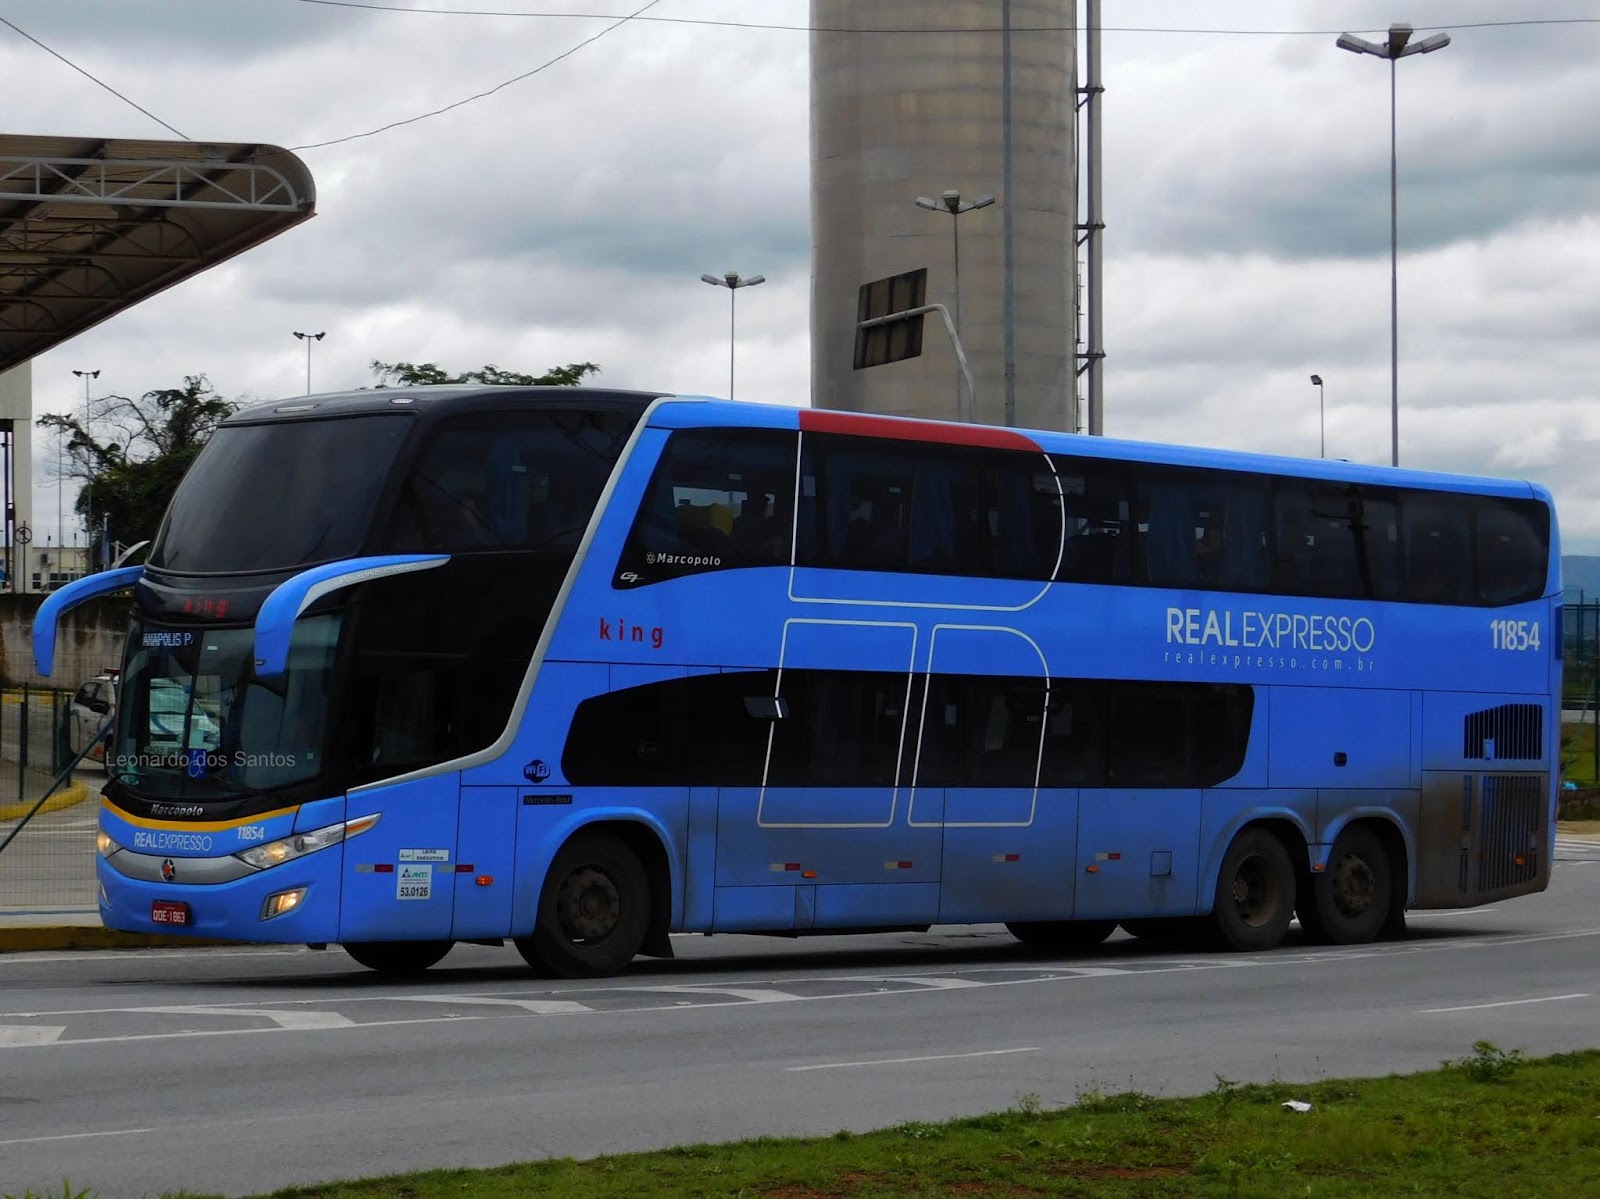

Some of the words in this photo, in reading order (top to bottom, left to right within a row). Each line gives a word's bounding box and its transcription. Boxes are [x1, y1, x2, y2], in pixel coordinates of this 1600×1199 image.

[657, 552, 721, 566] Marcopolo
[620, 571, 645, 583] G7
[184, 597, 228, 619] king
[600, 617, 664, 649] king
[1490, 619, 1541, 651] 11854
[1164, 651, 1375, 671] realexpresso.com.br
[151, 804, 204, 817] Marcopolo
[237, 826, 265, 840] 11854
[400, 887, 429, 897] 53.0126
